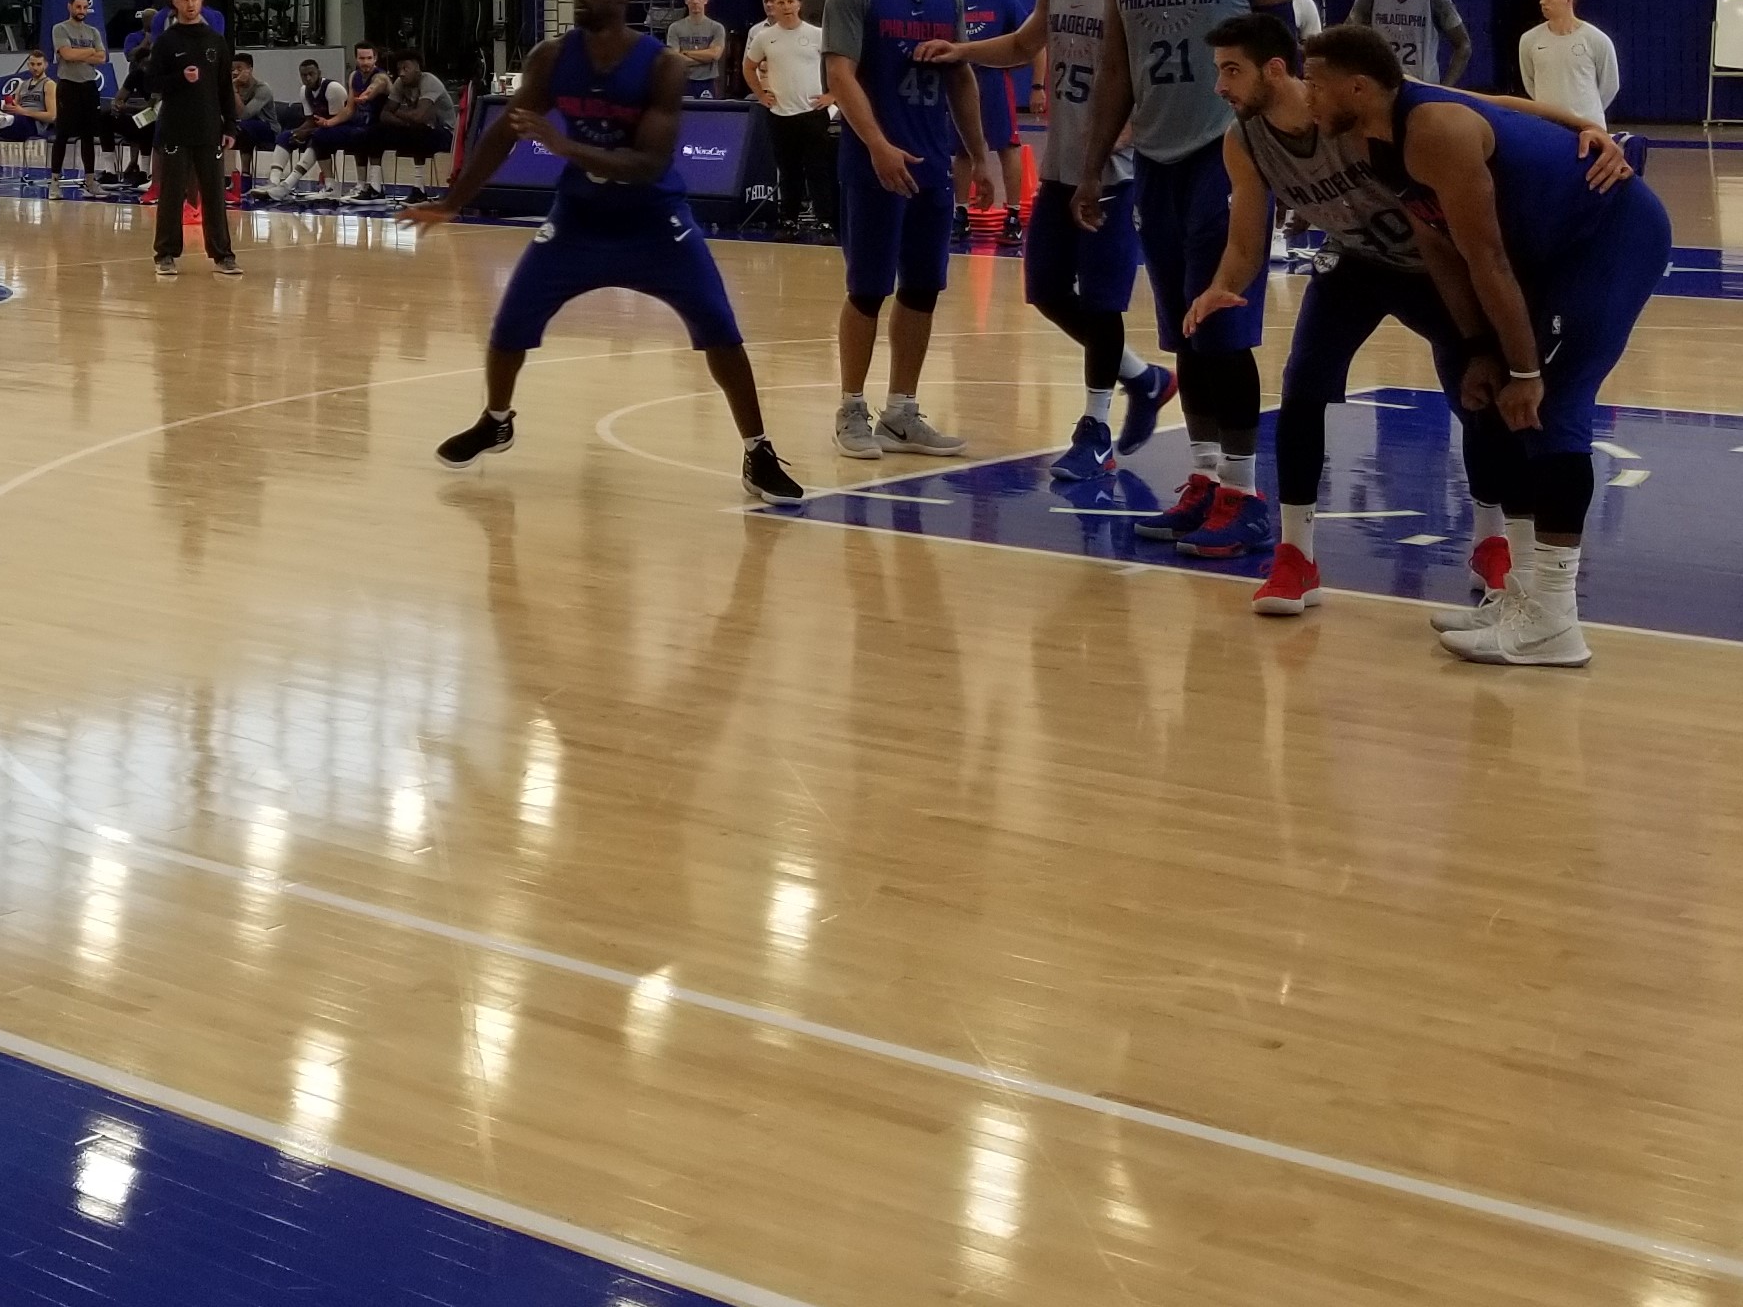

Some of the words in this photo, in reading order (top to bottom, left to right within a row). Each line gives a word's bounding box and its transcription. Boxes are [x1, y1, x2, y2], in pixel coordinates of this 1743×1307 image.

[1055, 62, 1094, 104] 25
[1149, 39, 1195, 86] 21
[897, 68, 938, 106] 43
